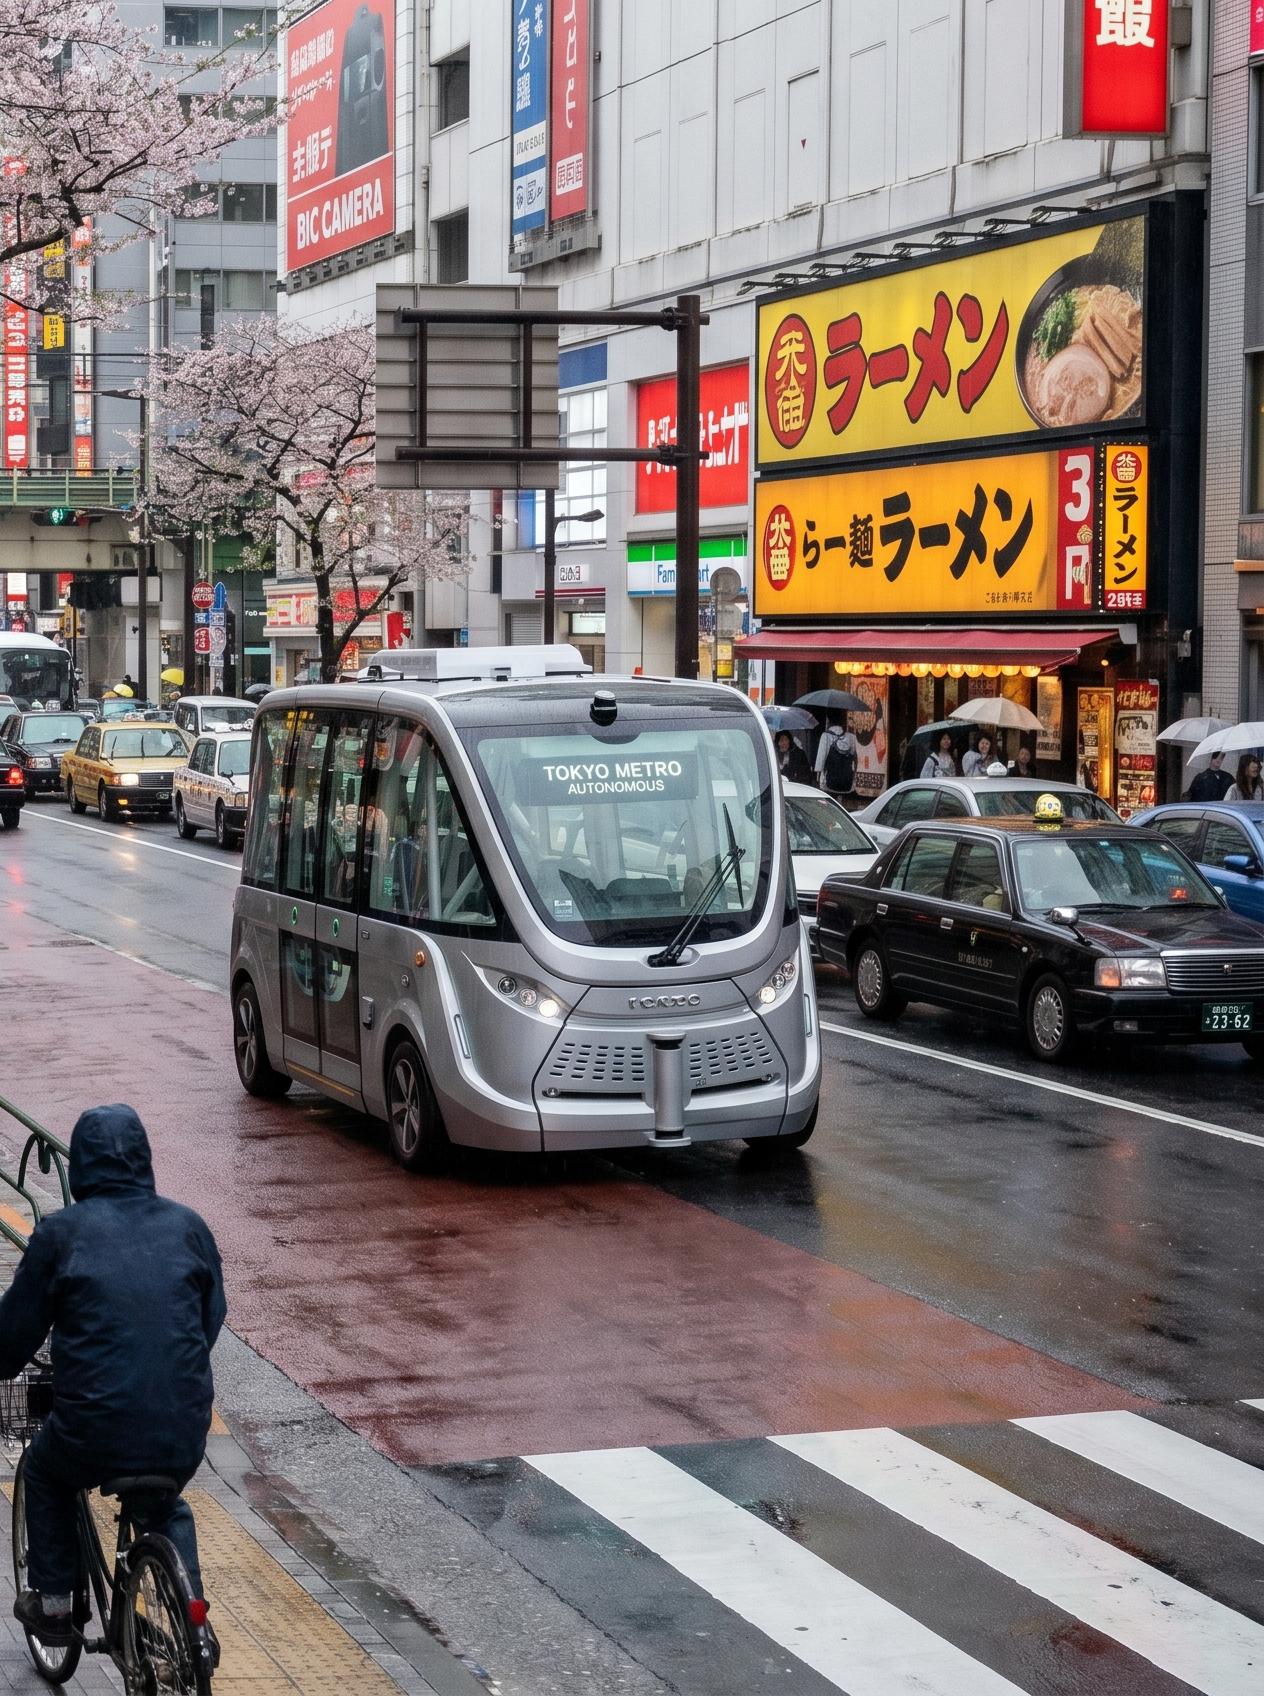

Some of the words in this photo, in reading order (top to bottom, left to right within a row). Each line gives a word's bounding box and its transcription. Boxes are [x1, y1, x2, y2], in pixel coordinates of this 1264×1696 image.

[296, 206, 319, 250] BIC
[321, 178, 384, 239] CAMERA
[823, 291, 1010, 435] ラーメン
[1112, 486, 1139, 585] ラーメン
[542, 763, 610, 781] TOKYO
[615, 760, 682, 779] METRO
[567, 779, 665, 795] AUTONOMOUS
[1212, 1014, 1250, 1029] 23-62
